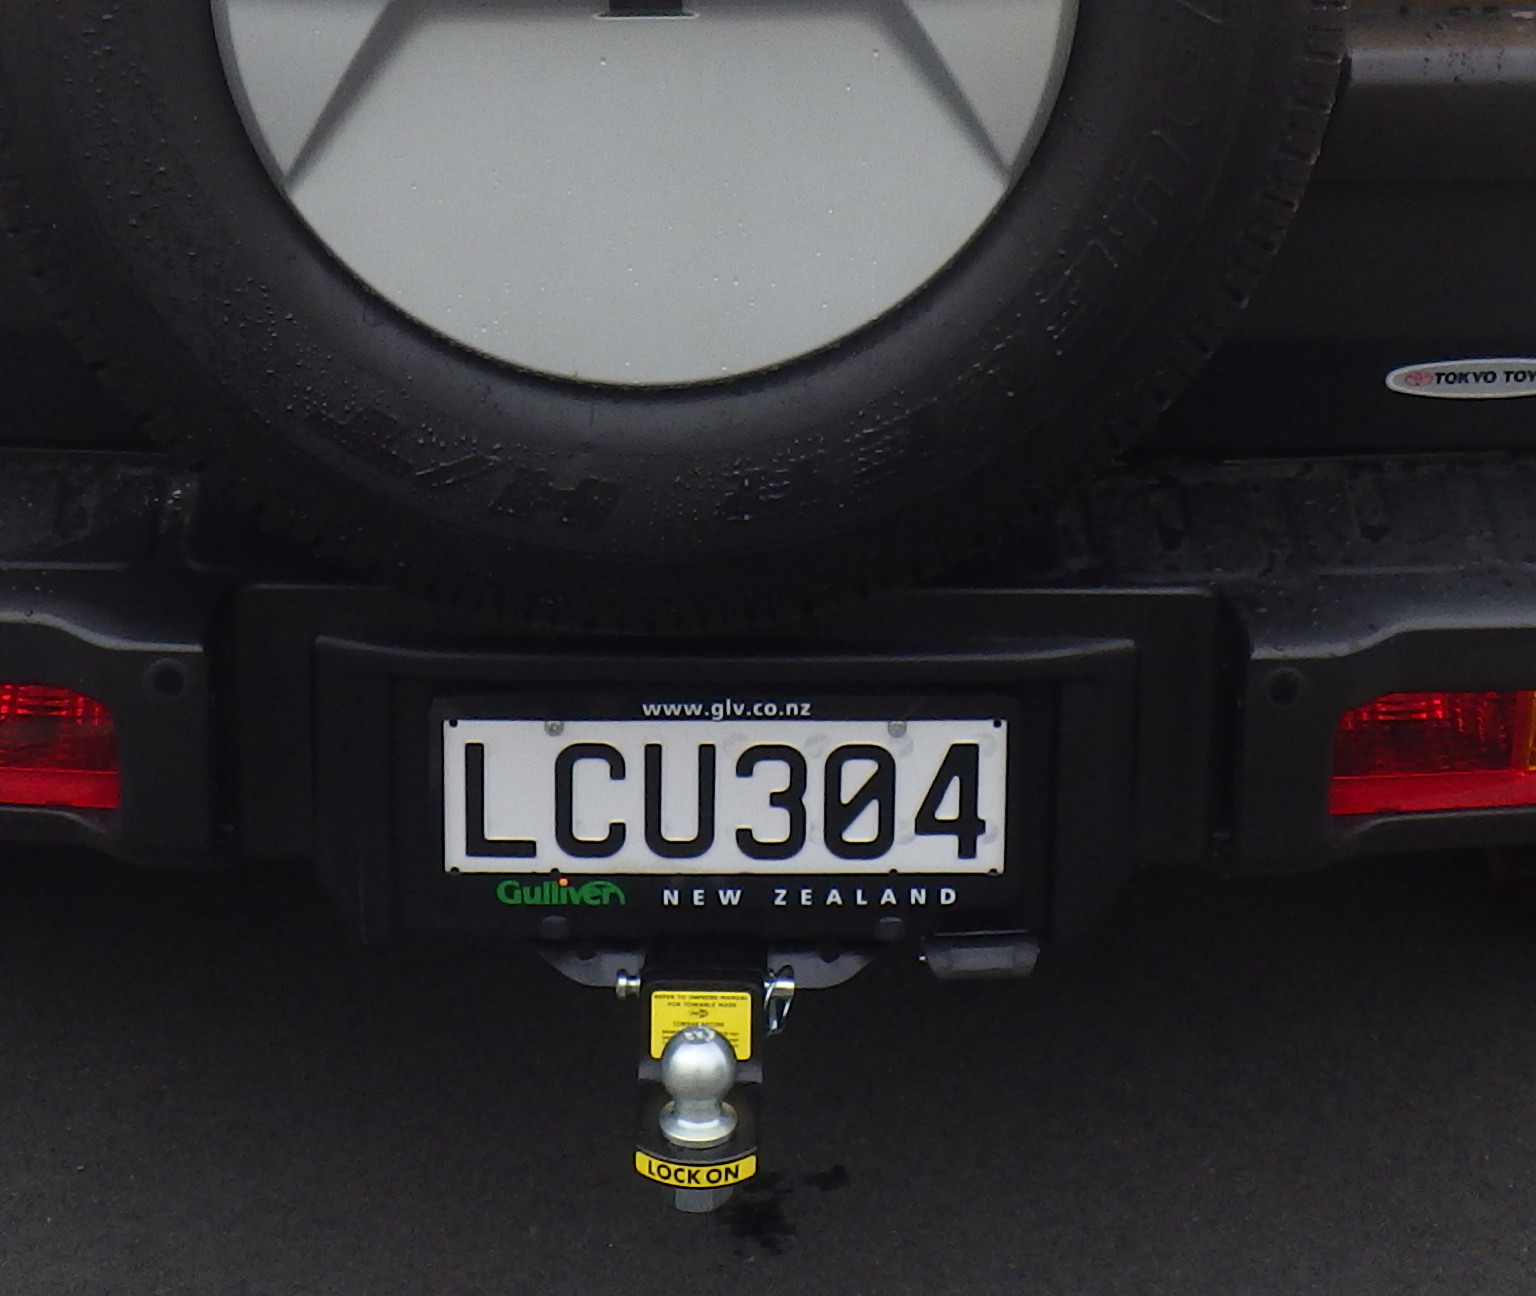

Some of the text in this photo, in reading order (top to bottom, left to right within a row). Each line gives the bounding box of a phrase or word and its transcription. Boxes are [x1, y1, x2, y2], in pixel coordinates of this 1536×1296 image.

[1434, 370, 1497, 385] TOKYO
[642, 699, 811, 720] www.glv.co.nz
[464, 741, 987, 861] LCU304
[496, 877, 958, 907] Gulliver NEW ZEALAND
[647, 1160, 740, 1185] LOCK ON
